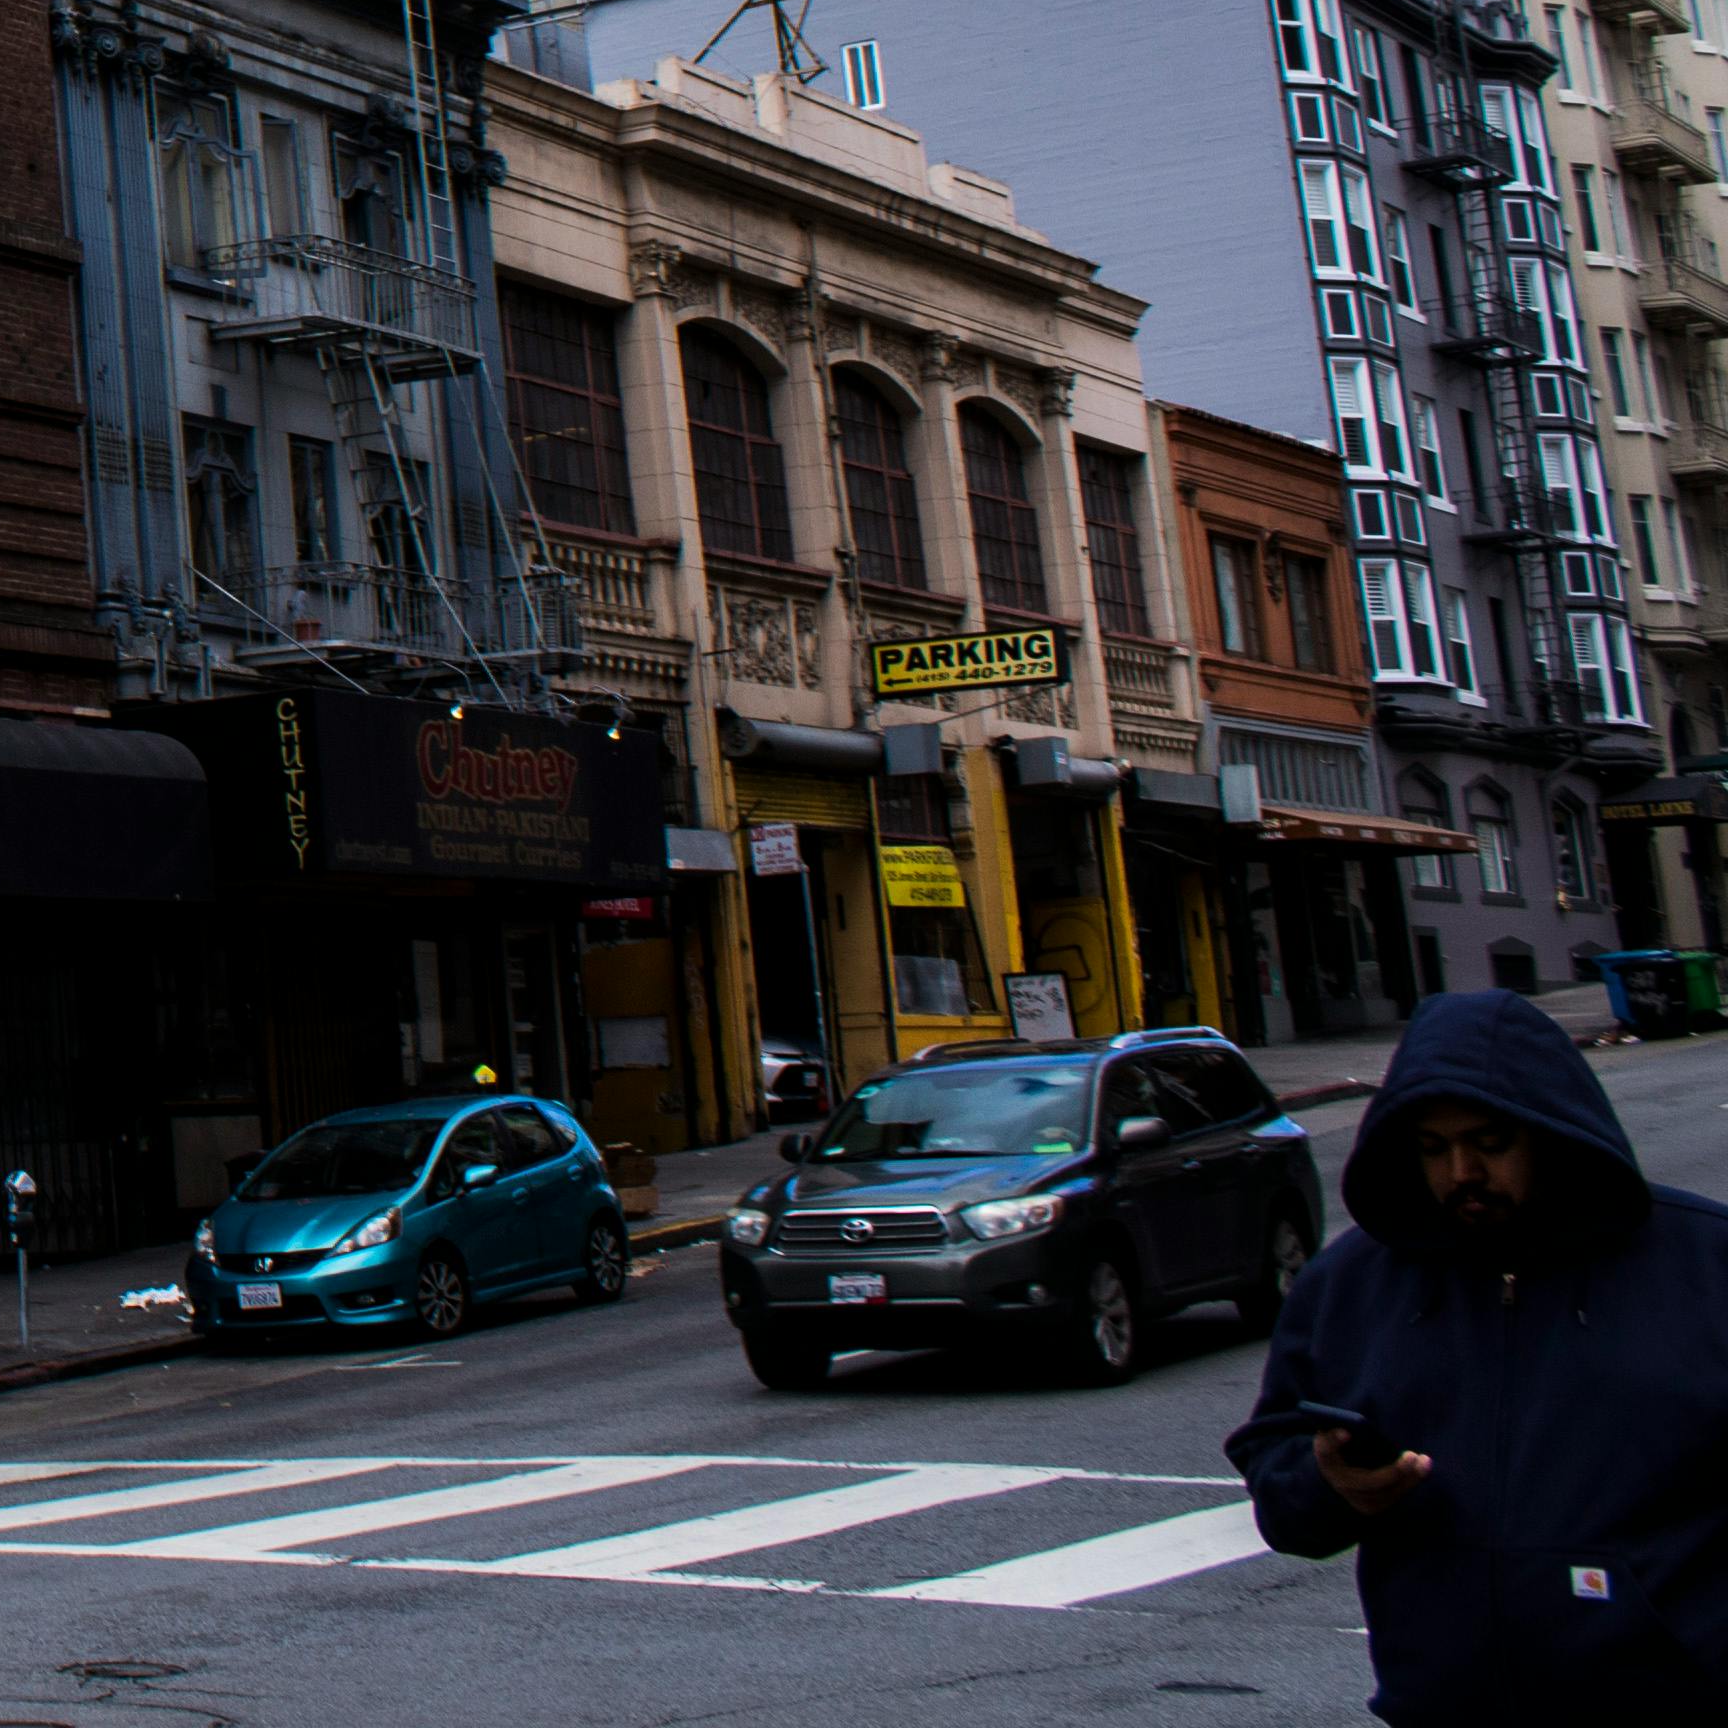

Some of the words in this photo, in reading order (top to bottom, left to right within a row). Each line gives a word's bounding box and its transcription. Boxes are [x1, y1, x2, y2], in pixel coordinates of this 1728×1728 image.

[879, 633, 1051, 674] PARKING
[954, 661, 1053, 681] 440-1279
[275, 696, 311, 872] CHUTNEY
[417, 719, 578, 815] Chutney
[431, 834, 509, 864] Gourmet
[515, 838, 584, 871] Curries
